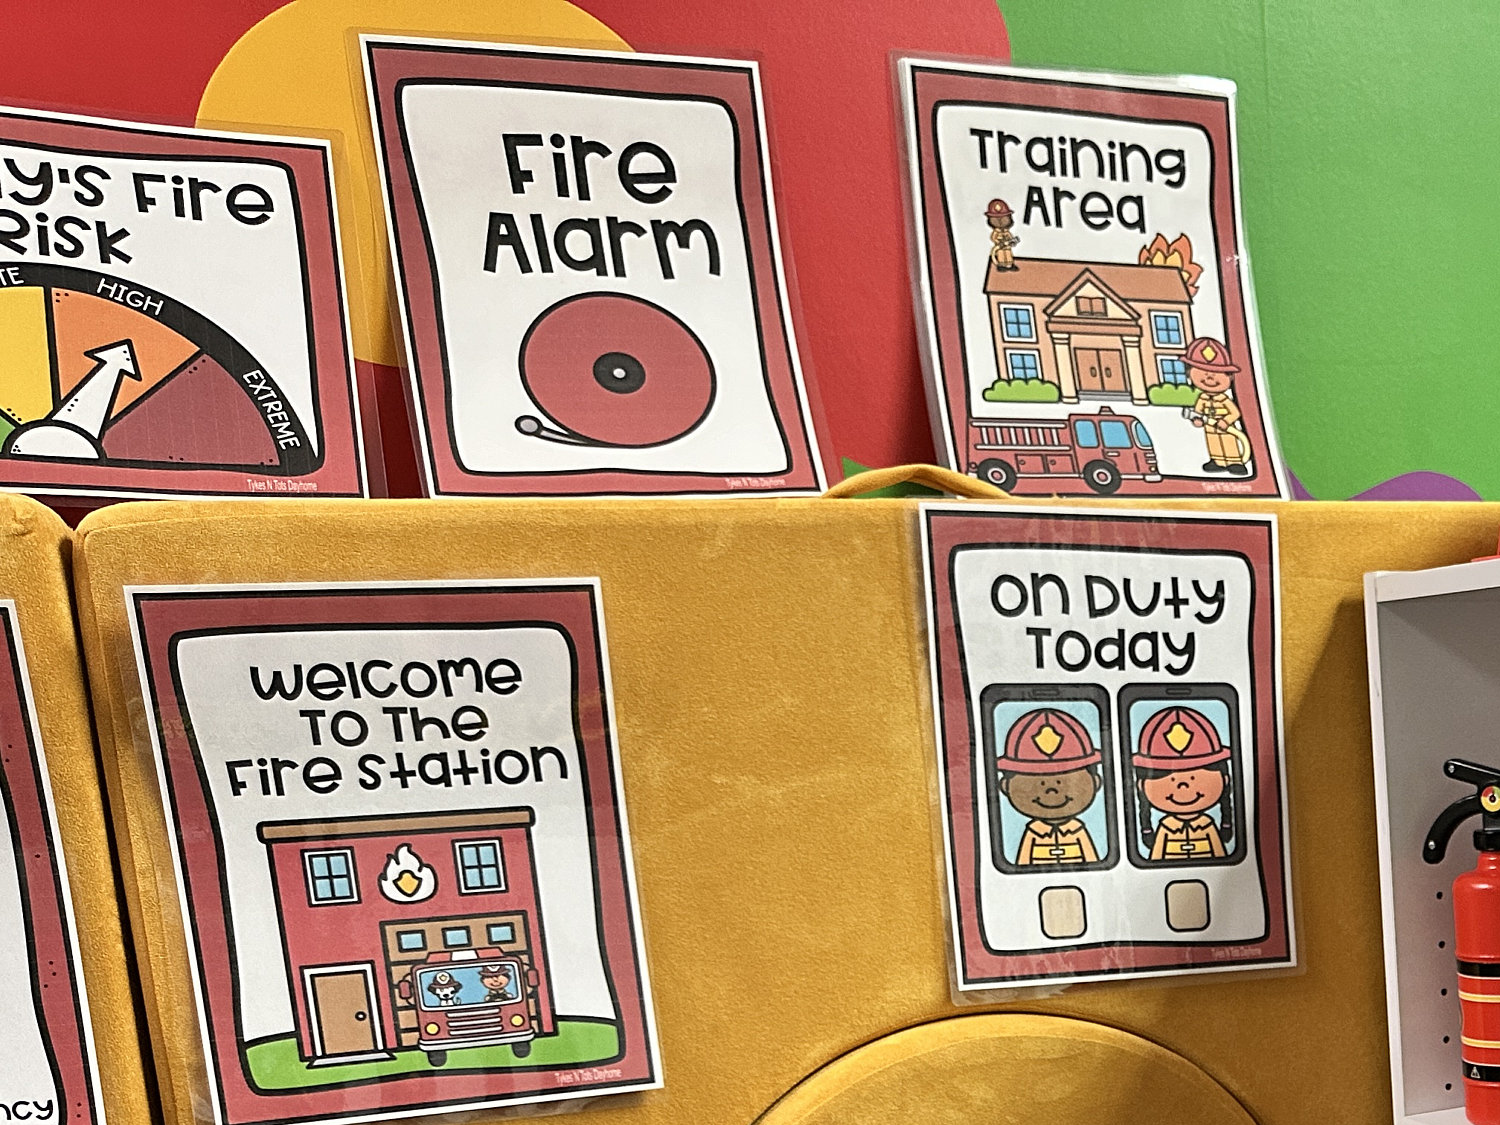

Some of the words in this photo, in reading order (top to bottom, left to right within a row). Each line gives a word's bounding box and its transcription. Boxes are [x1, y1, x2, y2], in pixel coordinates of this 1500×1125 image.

[502, 133, 677, 204] Fire
[970, 128, 1186, 189] Training
[0, 158, 111, 207] y's
[132, 172, 275, 226] Fire
[1023, 185, 1147, 234] Area
[483, 212, 721, 280] Alarm
[97, 278, 164, 316] HIGH
[242, 369, 300, 450] EXTREME
[266, 480, 273, 490] N
[990, 573, 1070, 618] On
[1085, 575, 1226, 625] Duty
[1026, 627, 1196, 676] Today
[249, 657, 523, 701] Welcome
[382, 705, 489, 743] The
[225, 757, 343, 797] Fire
[357, 746, 568, 791] Station
